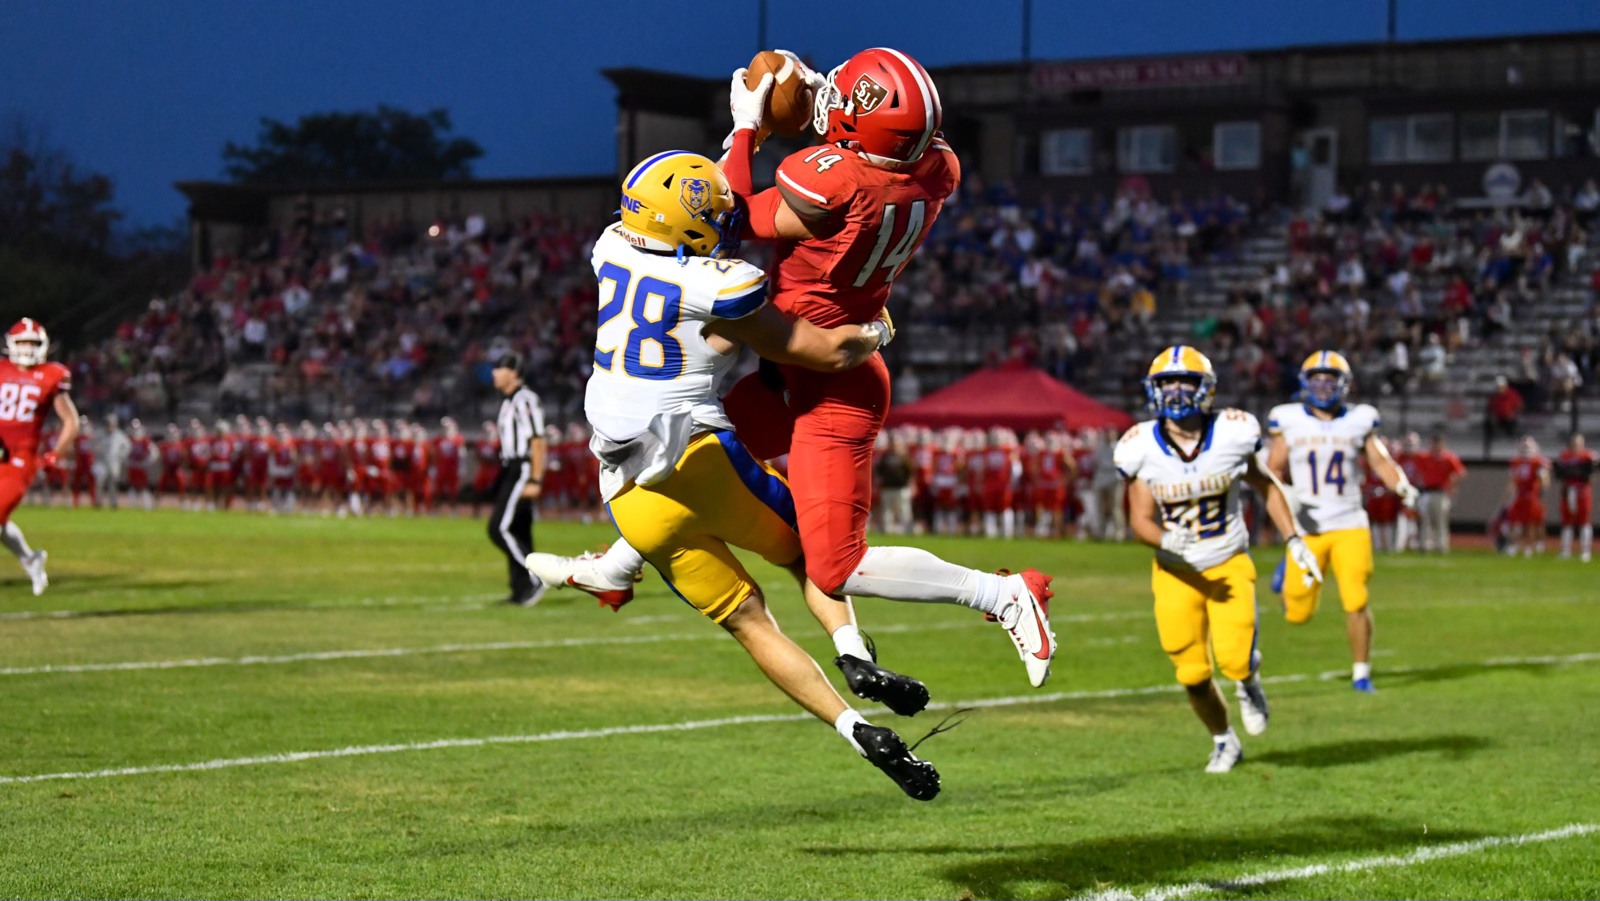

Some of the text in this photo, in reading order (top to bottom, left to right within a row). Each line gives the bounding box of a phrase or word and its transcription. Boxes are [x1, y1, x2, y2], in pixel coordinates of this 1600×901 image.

[854, 80, 878, 111] SLU
[803, 148, 844, 174] 14
[852, 200, 925, 288] 14
[594, 259, 687, 381] 28
[0, 382, 41, 422] 86
[1307, 449, 1347, 497] 14
